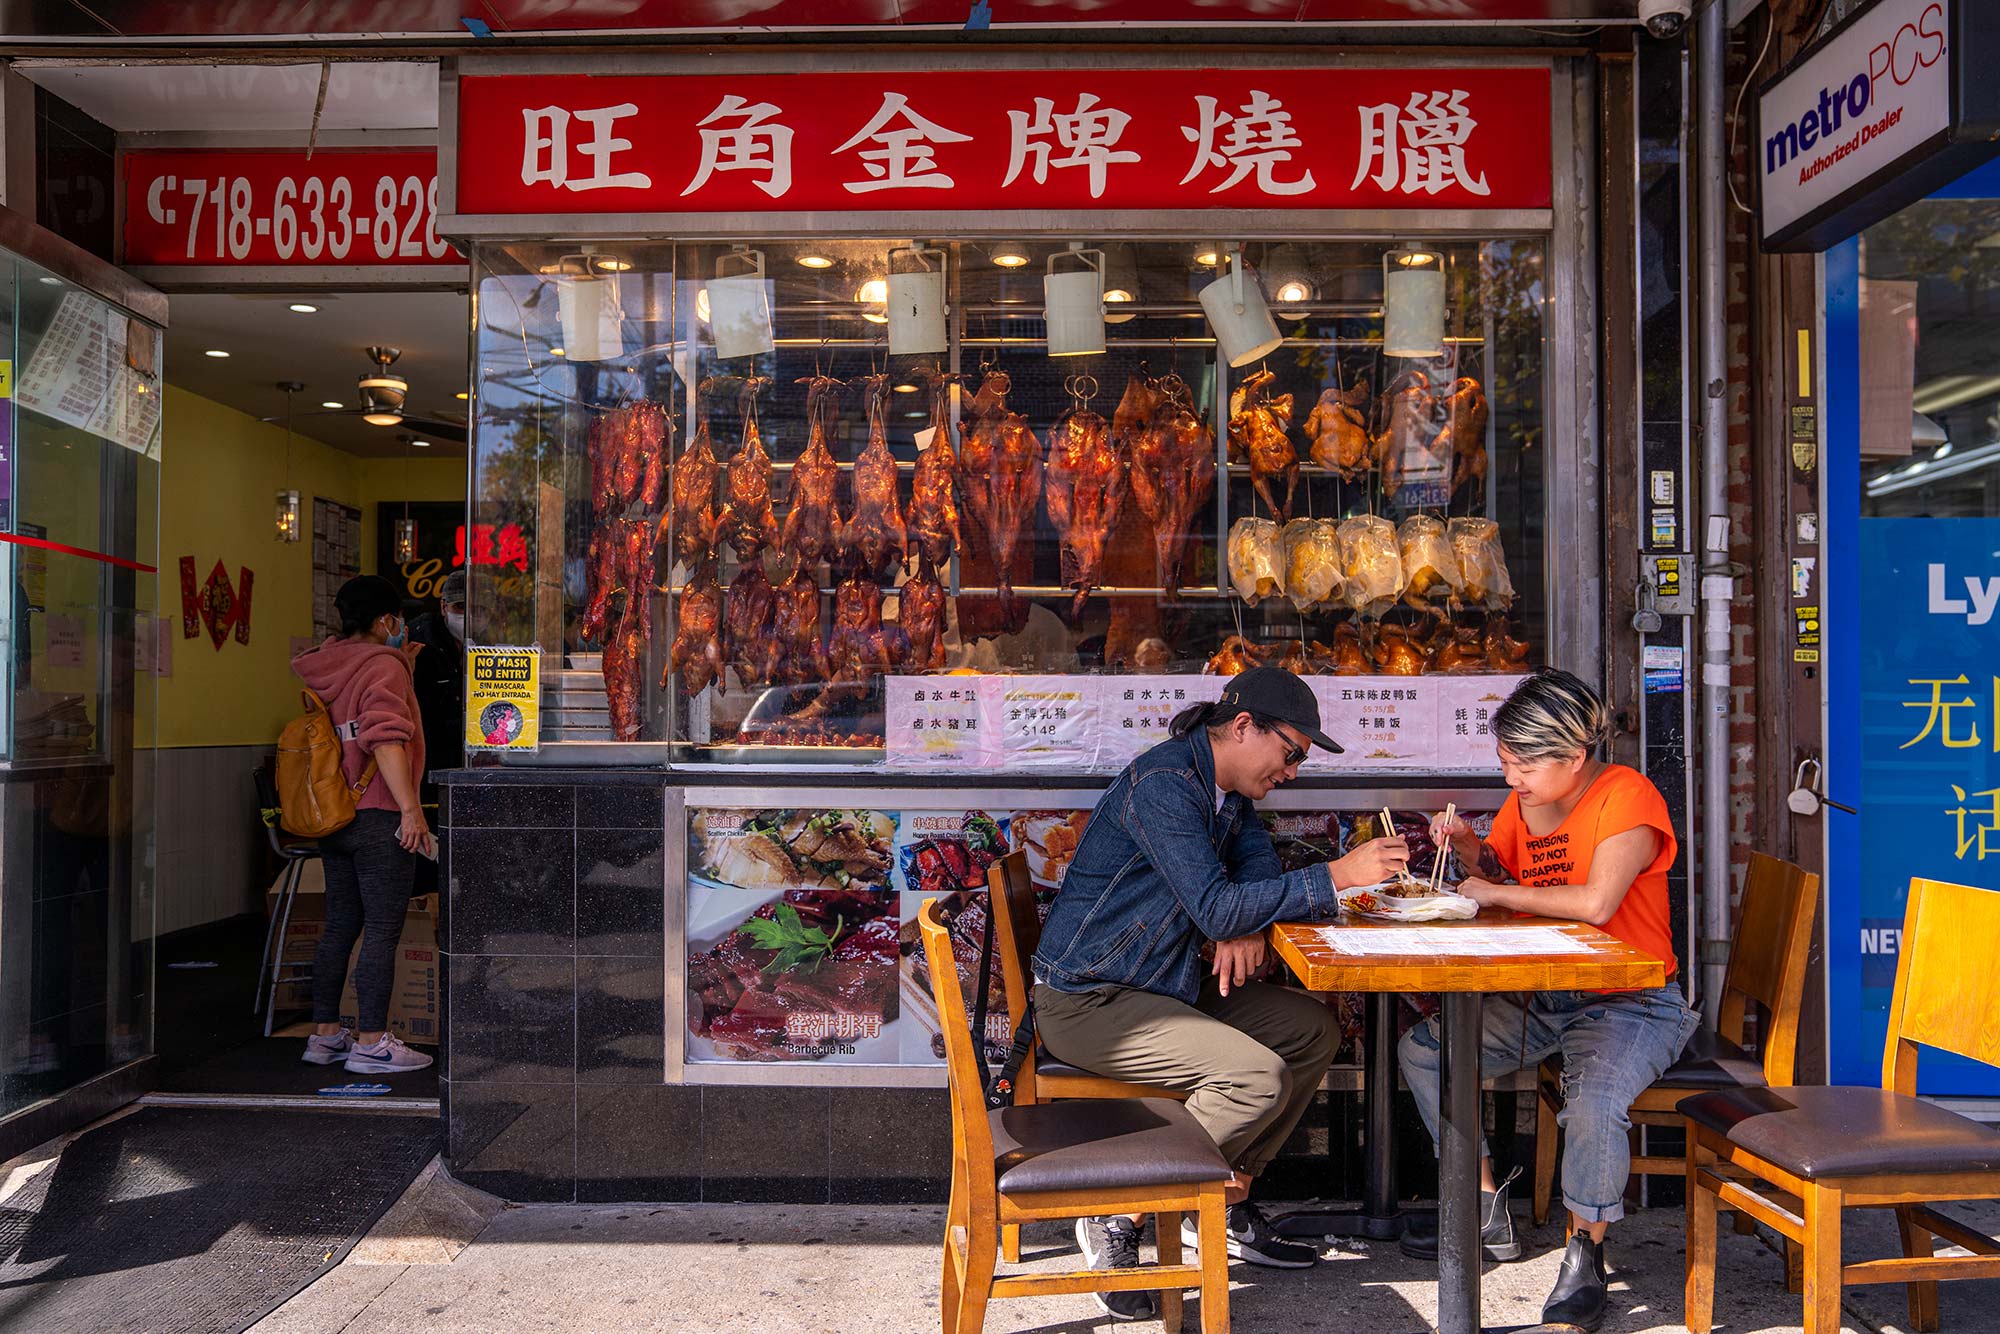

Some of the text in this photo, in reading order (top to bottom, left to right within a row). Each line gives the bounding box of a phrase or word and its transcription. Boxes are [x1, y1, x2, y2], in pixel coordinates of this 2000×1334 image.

[521, 90, 1491, 199] 旺角金牌燒臘
[1799, 106, 1904, 187] Authorized Dealer
[183, 176, 467, 260] 718-633-828
[1928, 563, 2000, 626] Ly
[477, 657, 529, 668] NO MASK
[477, 669, 529, 679] NO ENTRY
[479, 682, 492, 690] SIN
[1341, 689, 1417, 701] 五味陈皮鸭饭
[1010, 707, 1067, 720] 金牌乳猪
[1455, 708, 1488, 720] 蚝油
[1899, 674, 2000, 753] 无
[1122, 717, 1169, 728] 卤水猪
[1455, 723, 1489, 735] 蚝油
[1022, 725, 1056, 736] $148
[1526, 833, 1570, 851] PRISONS
[1532, 848, 1568, 864] DO NOT
[1861, 928, 1902, 954] NE
[786, 1012, 883, 1038] 蜜汁排骨
[788, 1043, 856, 1055] Barbecue Rib
